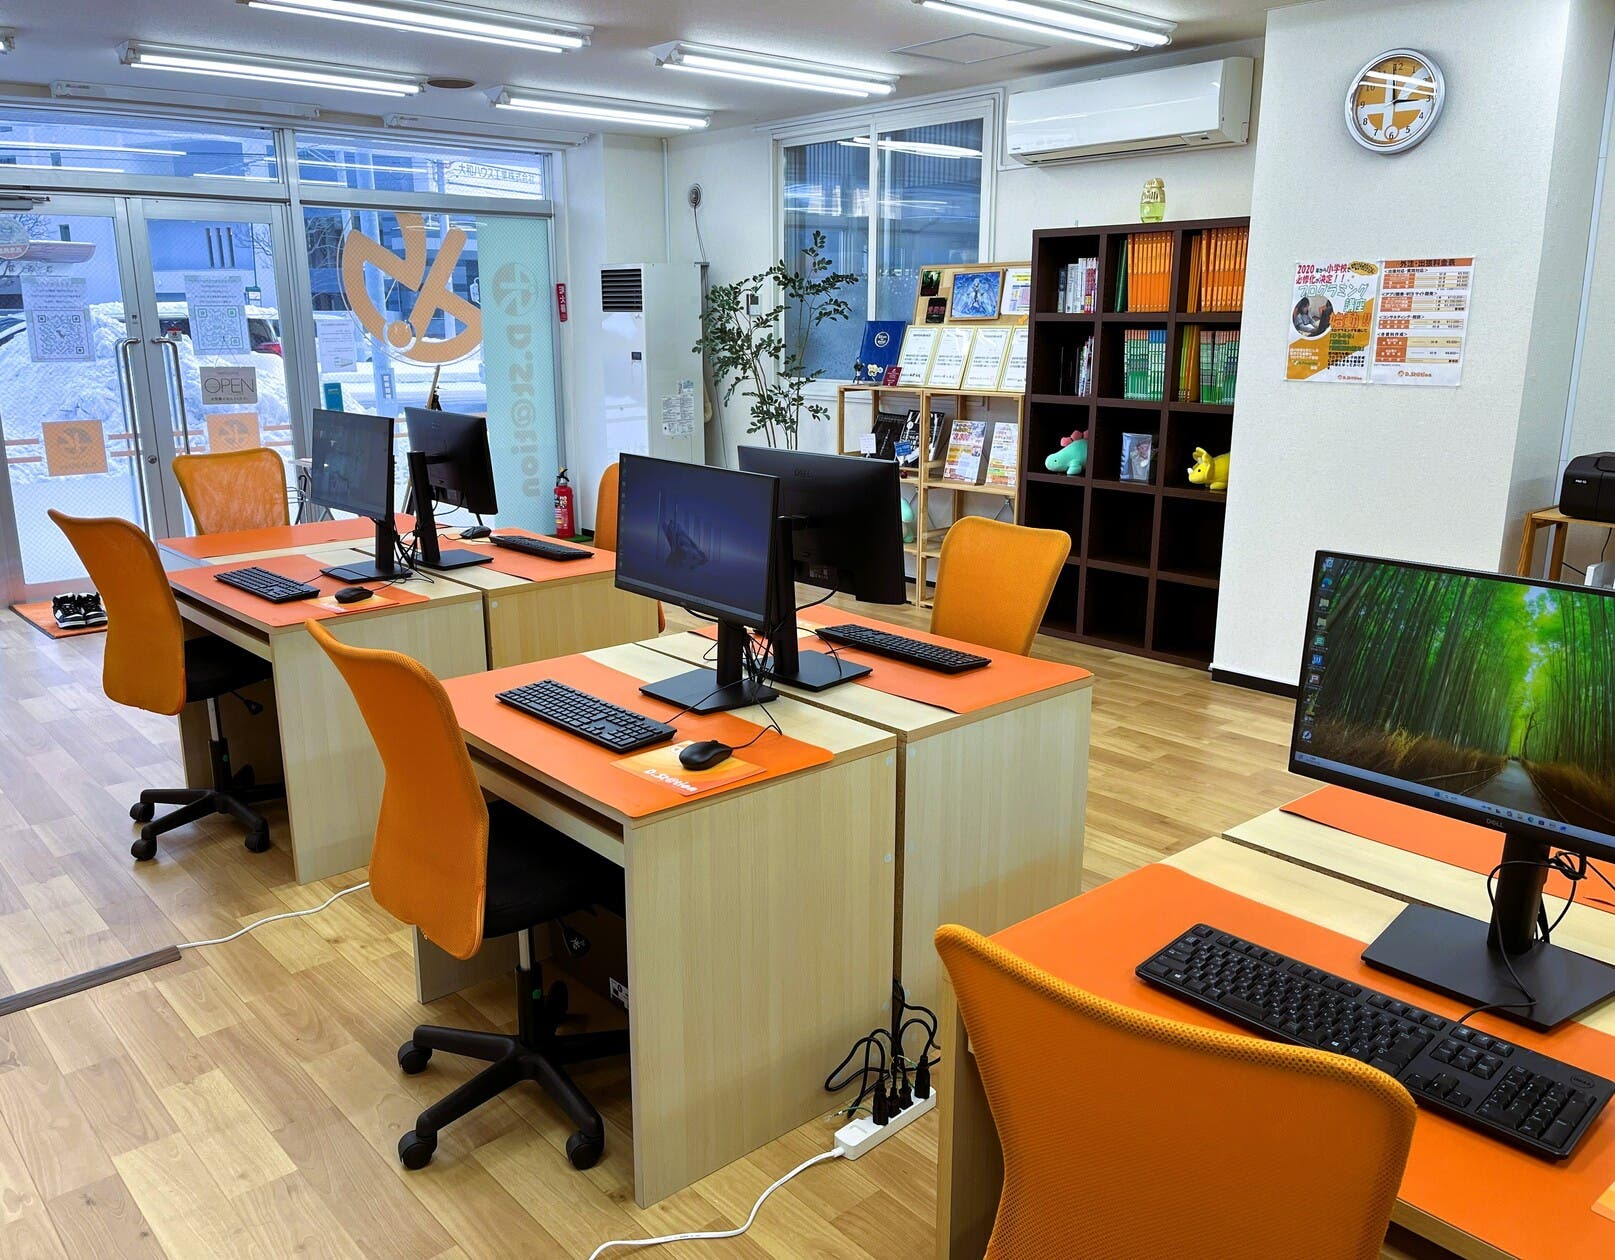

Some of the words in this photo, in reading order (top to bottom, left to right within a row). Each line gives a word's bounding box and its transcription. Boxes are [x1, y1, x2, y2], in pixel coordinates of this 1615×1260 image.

[1360, 101, 1366, 109] 9
[1373, 128, 1379, 136] 7
[1405, 126, 1411, 134] 5
[1298, 283, 1370, 298] プログラミング
[1343, 298, 1367, 312] 講座
[204, 377, 255, 394] OPEN
